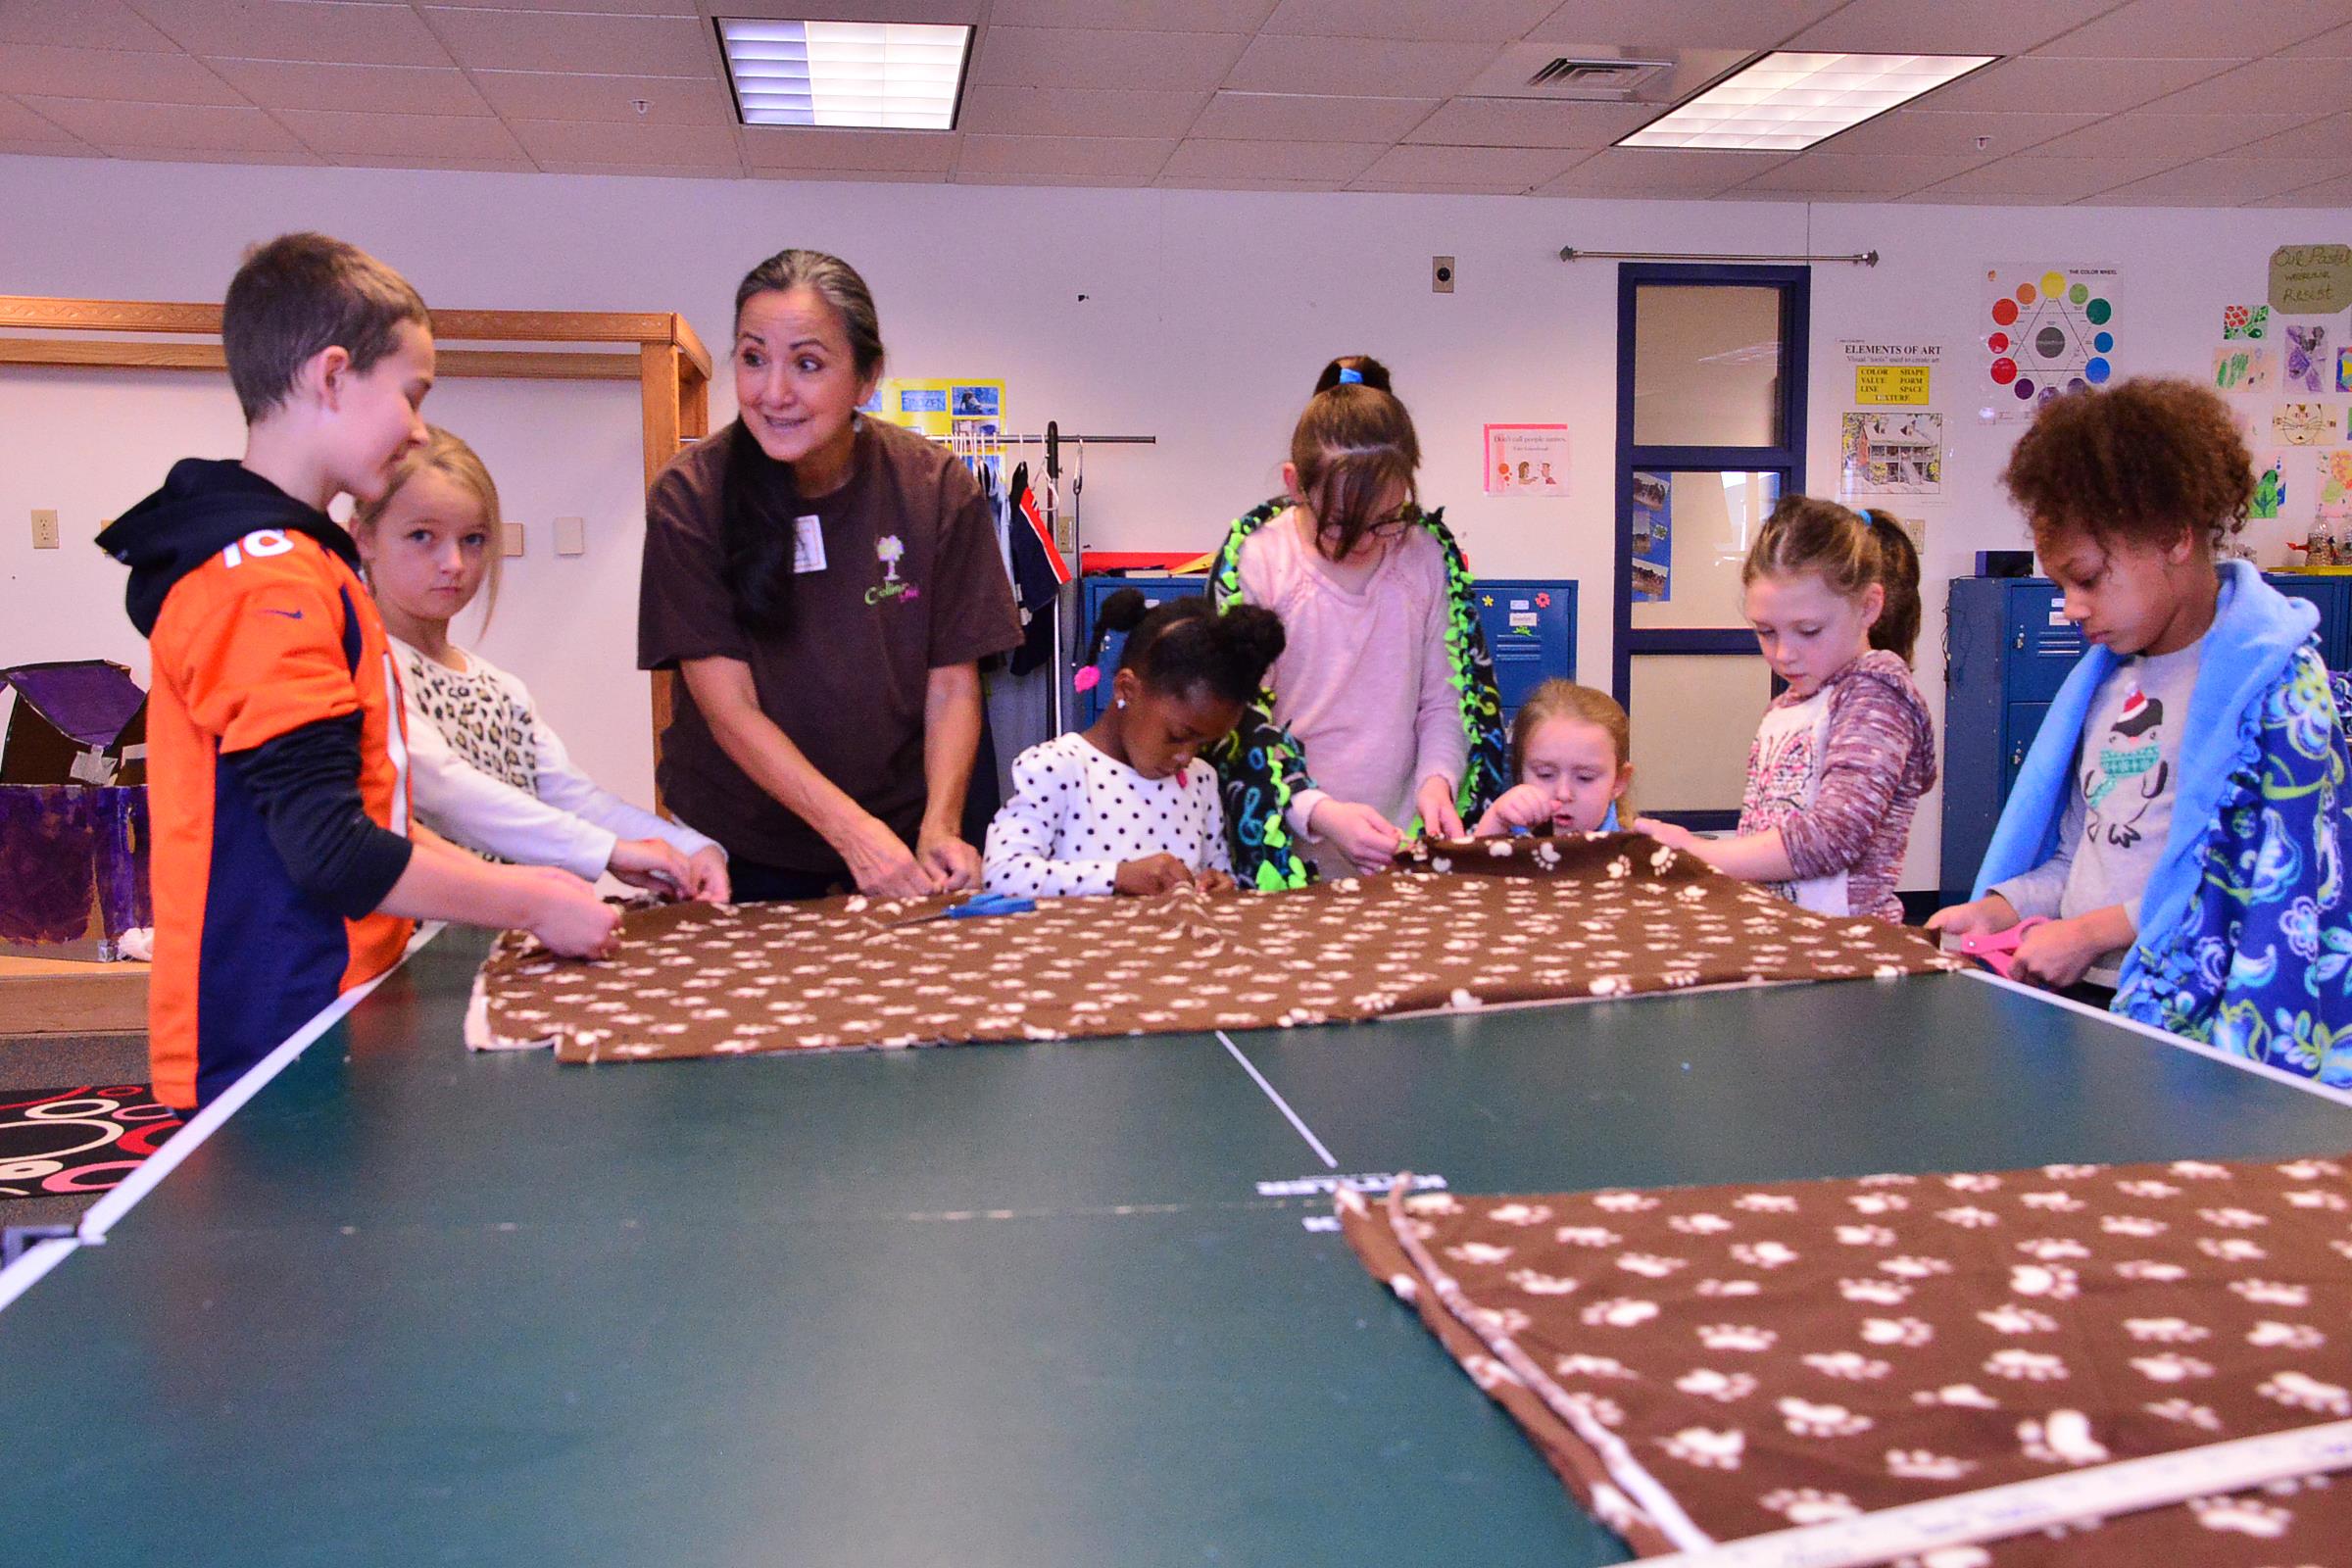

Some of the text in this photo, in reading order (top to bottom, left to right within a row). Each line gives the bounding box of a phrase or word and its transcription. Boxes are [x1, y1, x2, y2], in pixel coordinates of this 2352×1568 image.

[1845, 345, 1941, 355] ELEMENTS OF ART
